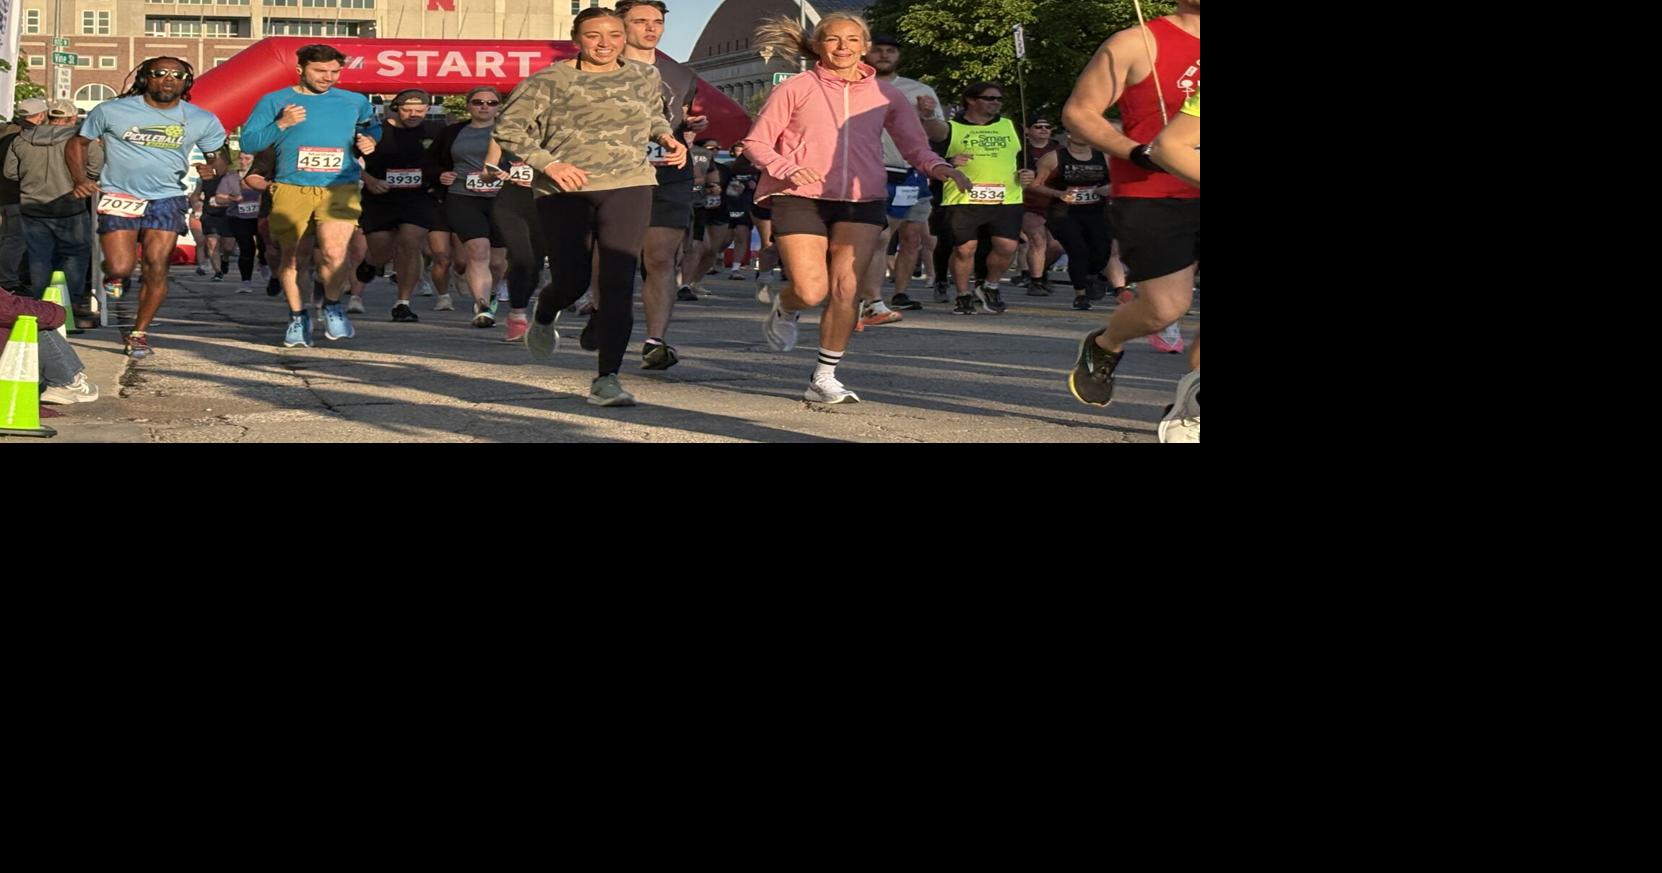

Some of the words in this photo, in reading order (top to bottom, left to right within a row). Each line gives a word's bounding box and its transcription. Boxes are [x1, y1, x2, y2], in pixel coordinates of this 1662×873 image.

[55, 53, 67, 64] Vine
[68, 54, 75, 65] St
[377, 50, 541, 78] START
[122, 131, 184, 145] PICKLEBALL
[979, 134, 1011, 142] Smart
[970, 139, 1007, 149] Pacing
[300, 156, 342, 168] 4512
[387, 175, 421, 184] 3939
[511, 170, 531, 180] 45
[970, 190, 1005, 199] 8534
[101, 198, 145, 211] 7077
